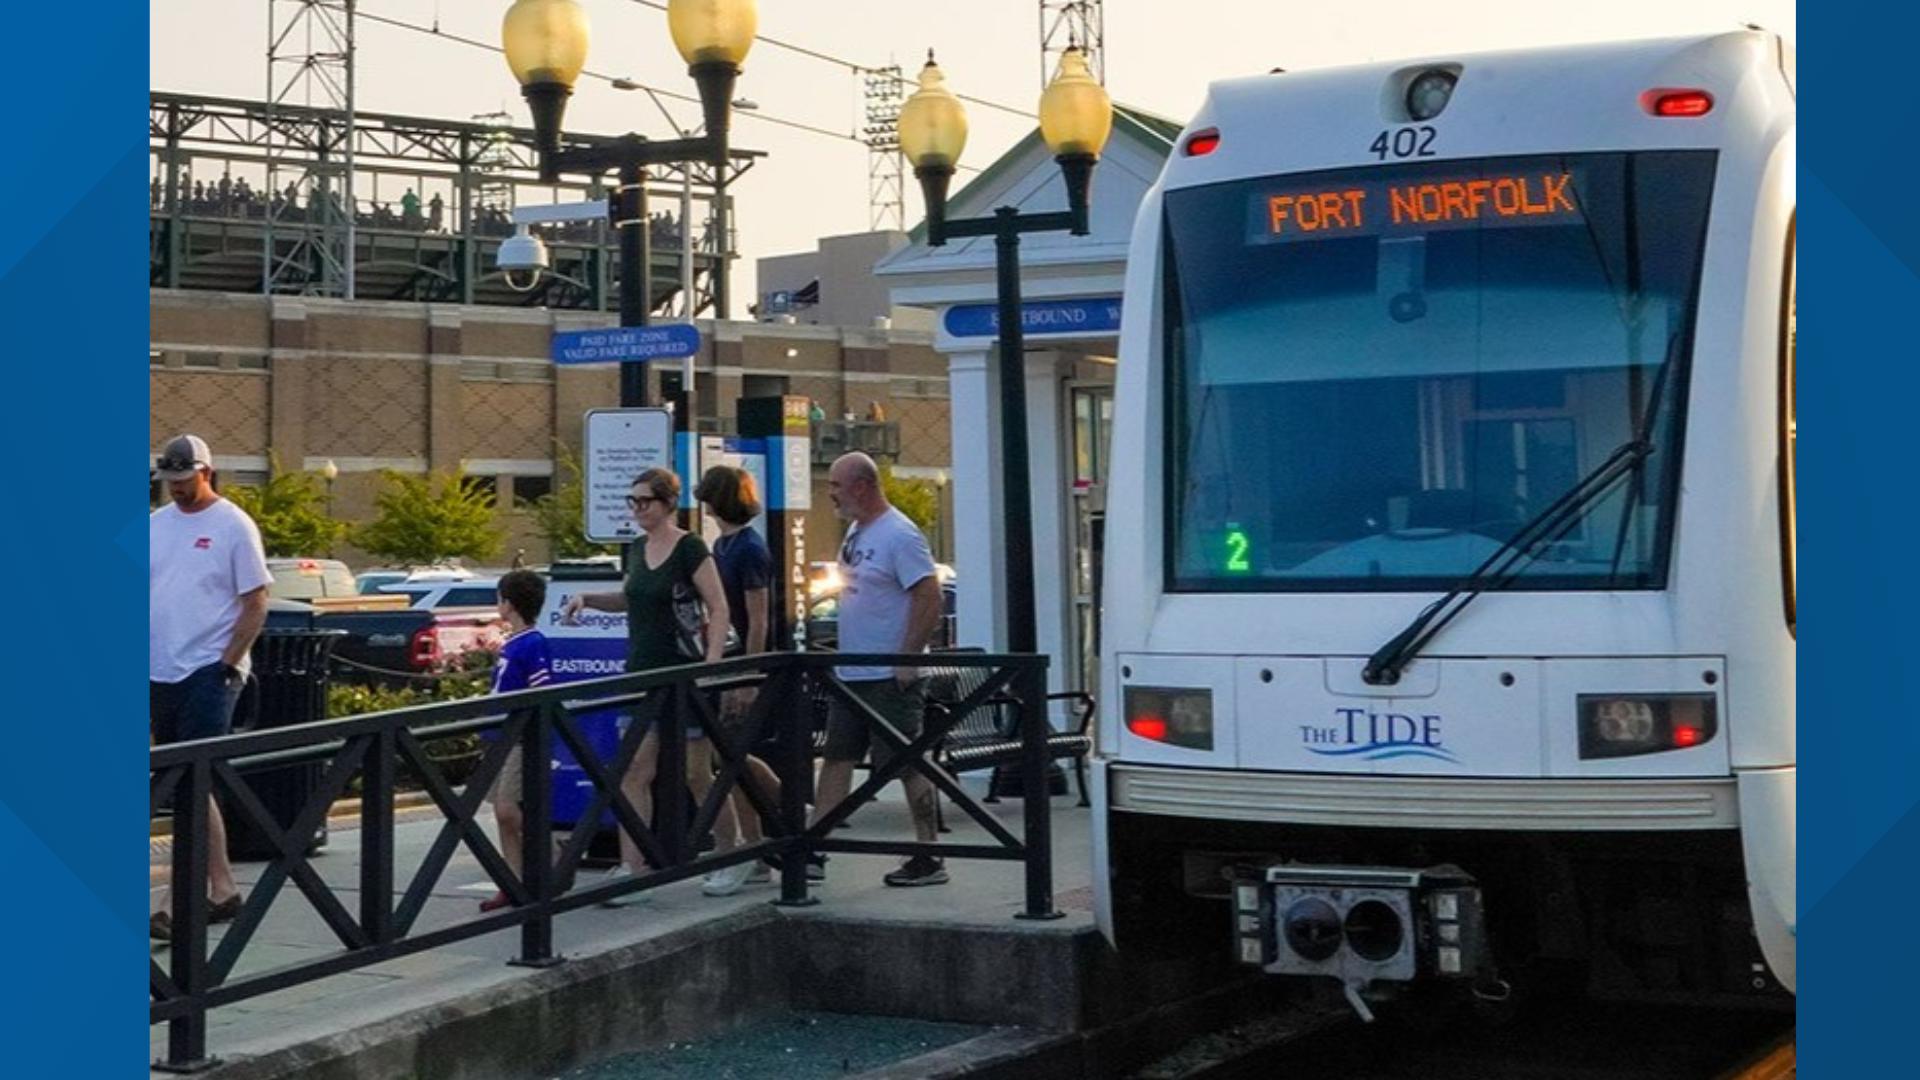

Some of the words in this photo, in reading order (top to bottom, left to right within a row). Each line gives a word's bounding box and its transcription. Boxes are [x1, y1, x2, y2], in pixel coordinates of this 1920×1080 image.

[1369, 126, 1437, 160] 402
[1269, 190, 1366, 234] FORT
[1390, 172, 1575, 224] NORFOLK
[990, 308, 1087, 327] ETBOUND
[791, 517, 805, 584] Park
[1226, 532, 1249, 571] 2
[550, 612, 628, 630] Psenger
[792, 587, 806, 653] rbor
[1300, 726, 1338, 743] THE
[1336, 708, 1442, 746] TIDE
